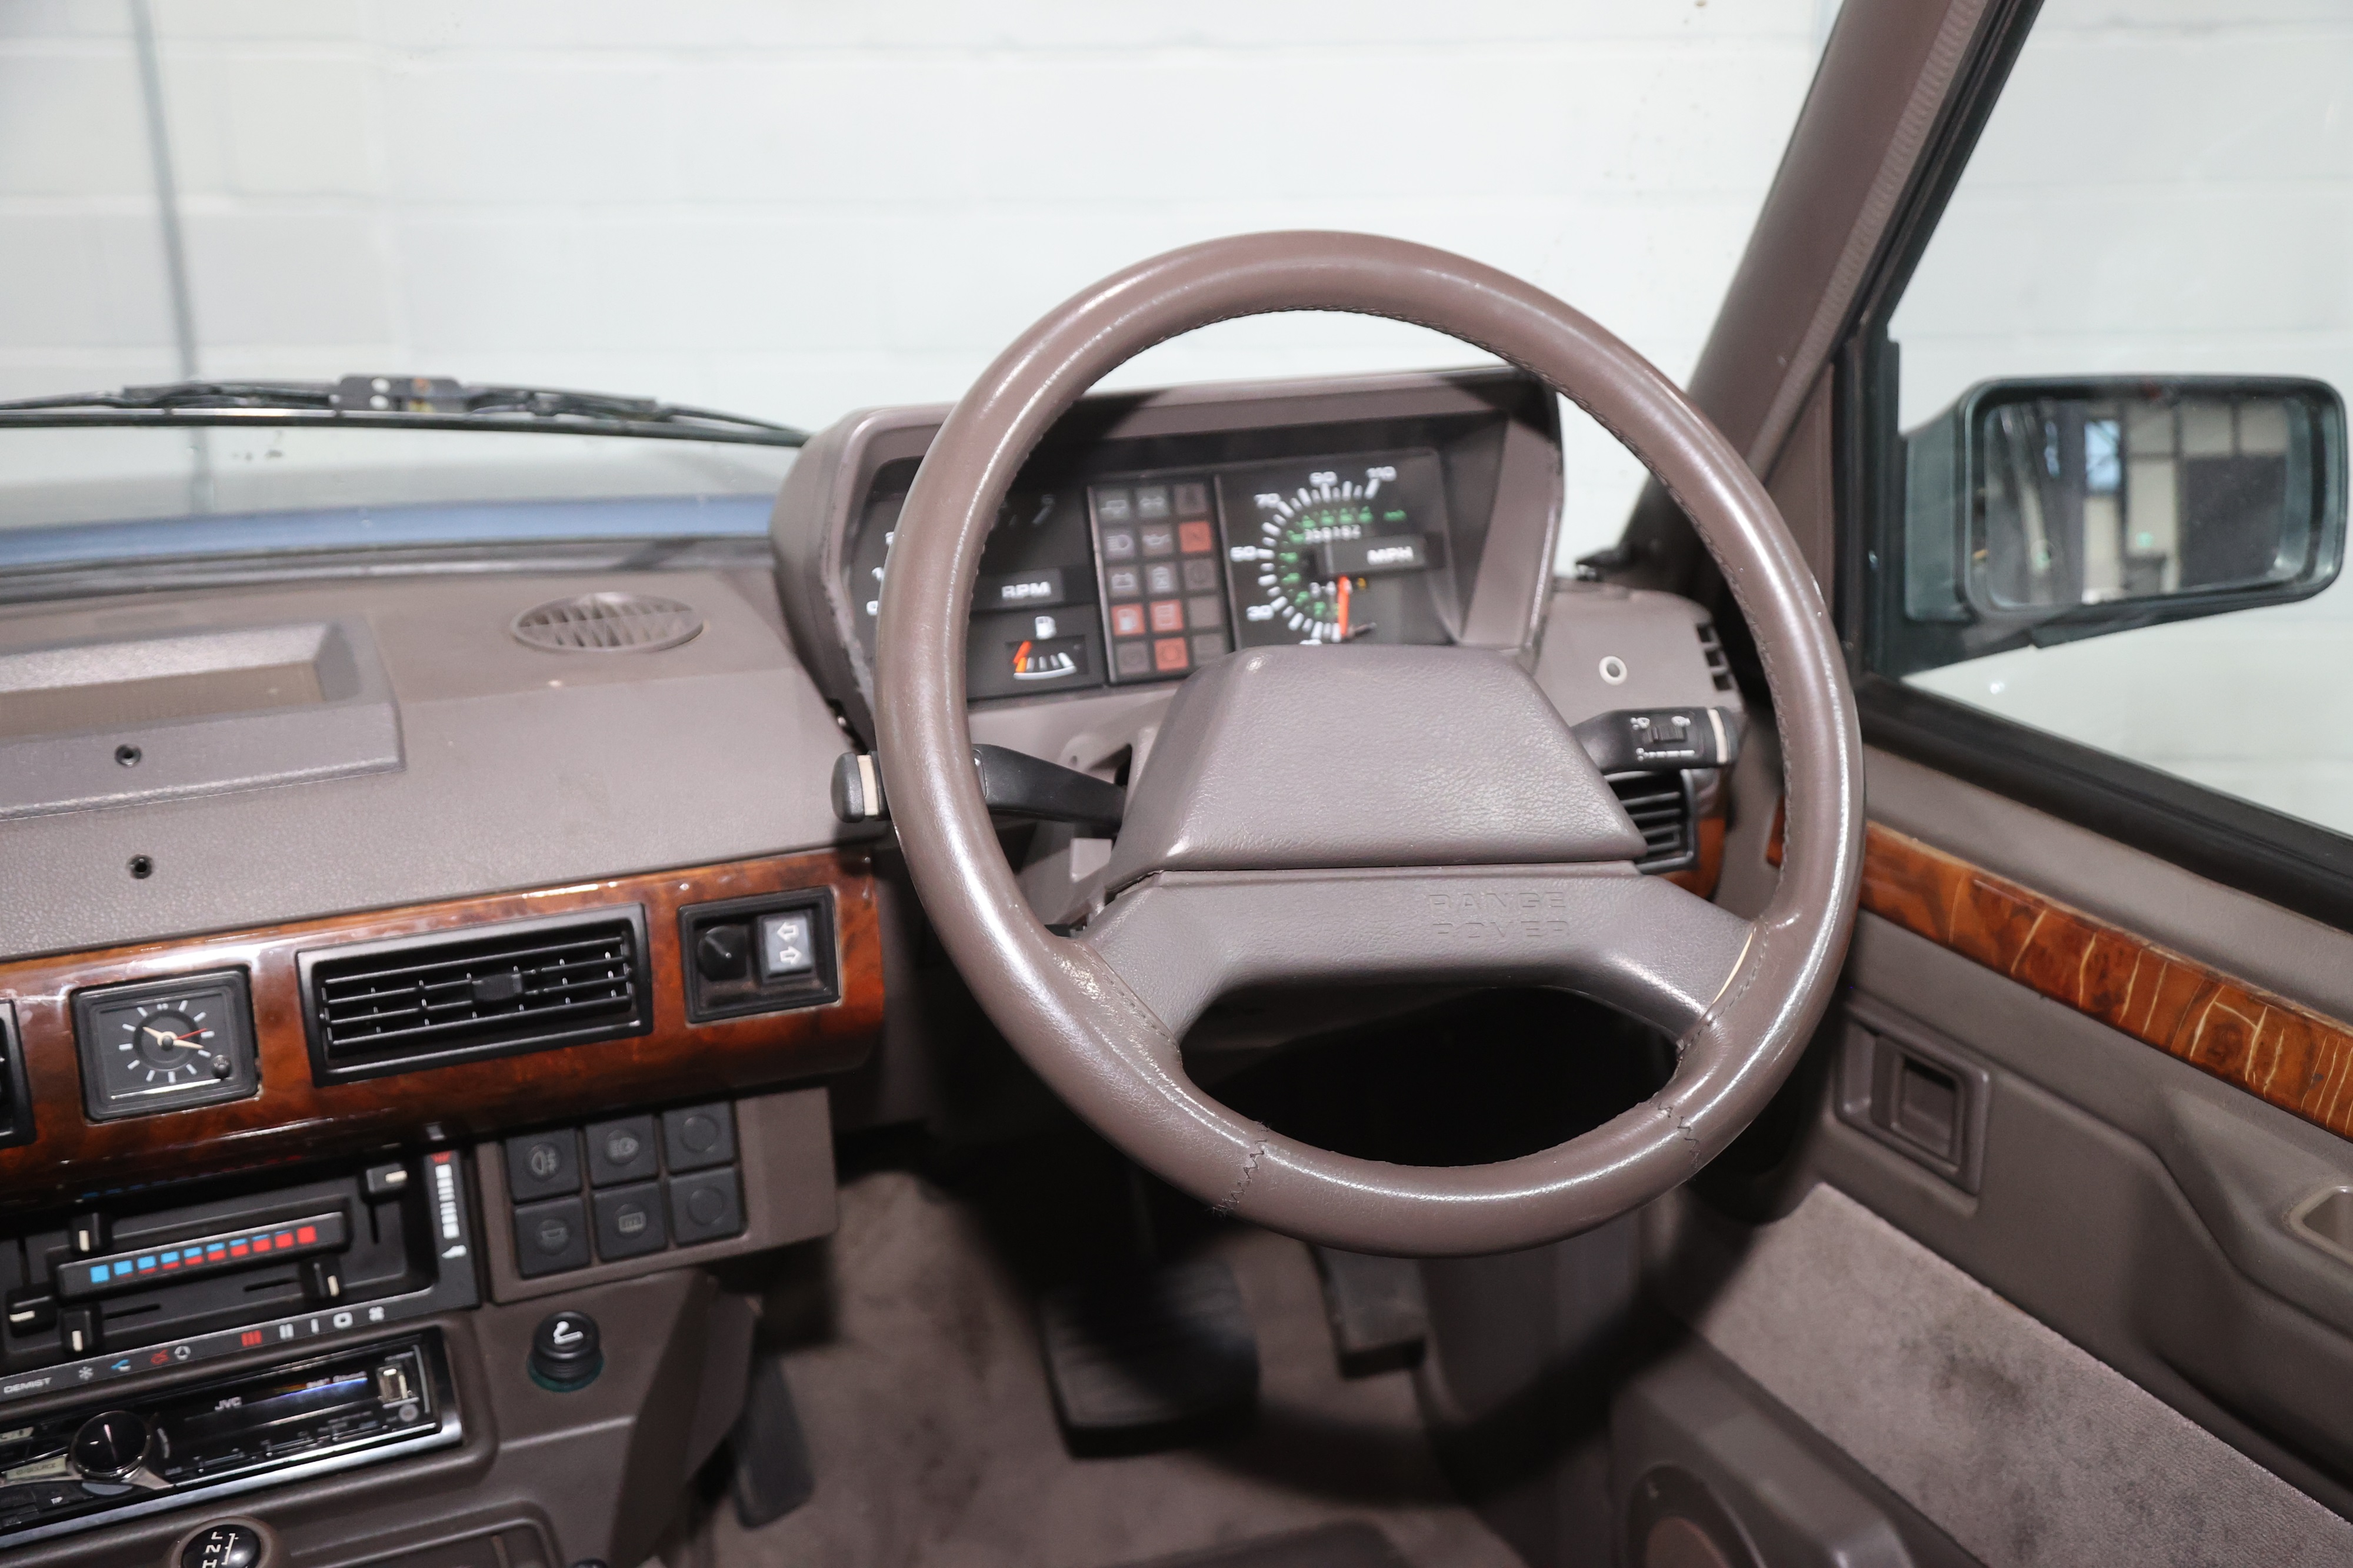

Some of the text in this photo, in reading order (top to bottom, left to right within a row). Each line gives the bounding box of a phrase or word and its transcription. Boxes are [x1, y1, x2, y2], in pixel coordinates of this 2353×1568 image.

[1254, 493, 1281, 509] 70
[1367, 546, 1414, 565] MPH
[1001, 581, 1051, 599] RPM
[1429, 892, 1566, 908] RANGE
[1432, 920, 1569, 938] ROVER
[4, 1377, 52, 1394] DEMIST
[215, 1396, 242, 1412] JVC
[211, 1532, 223, 1540] L
[205, 1544, 221, 1553] N
[202, 1559, 218, 1568] H
